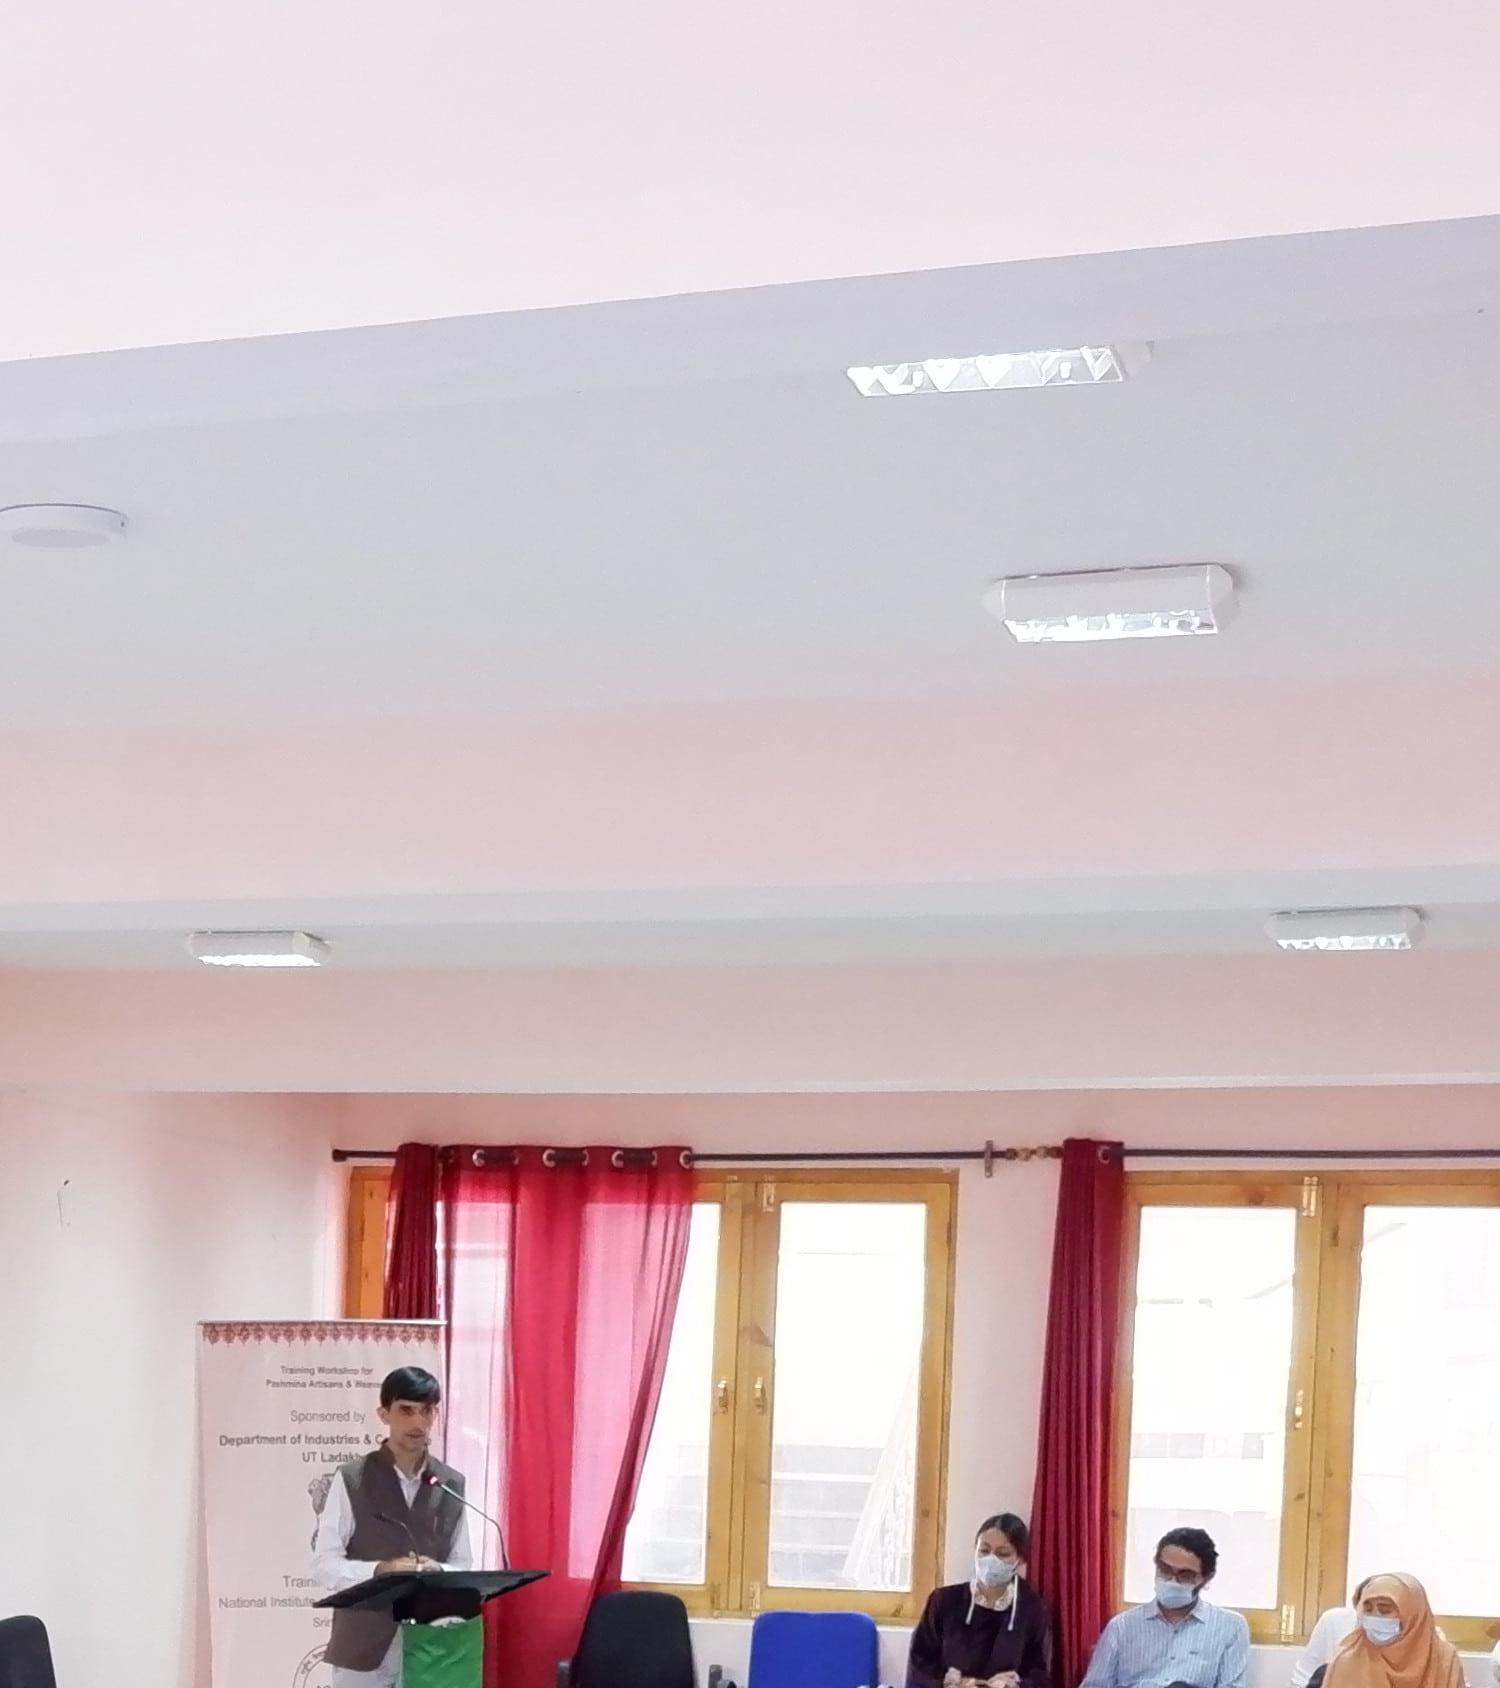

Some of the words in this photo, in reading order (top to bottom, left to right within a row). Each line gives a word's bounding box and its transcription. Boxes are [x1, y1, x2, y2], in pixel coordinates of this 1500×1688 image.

[290, 1409, 351, 1424] Sponsored
[353, 1410, 366, 1424] by
[219, 1434, 287, 1448] Department
[290, 1434, 301, 1445] of
[304, 1434, 360, 1445] Industries
[363, 1434, 372, 1445] &
[302, 1452, 317, 1463] UT
[218, 1597, 267, 1608] National
